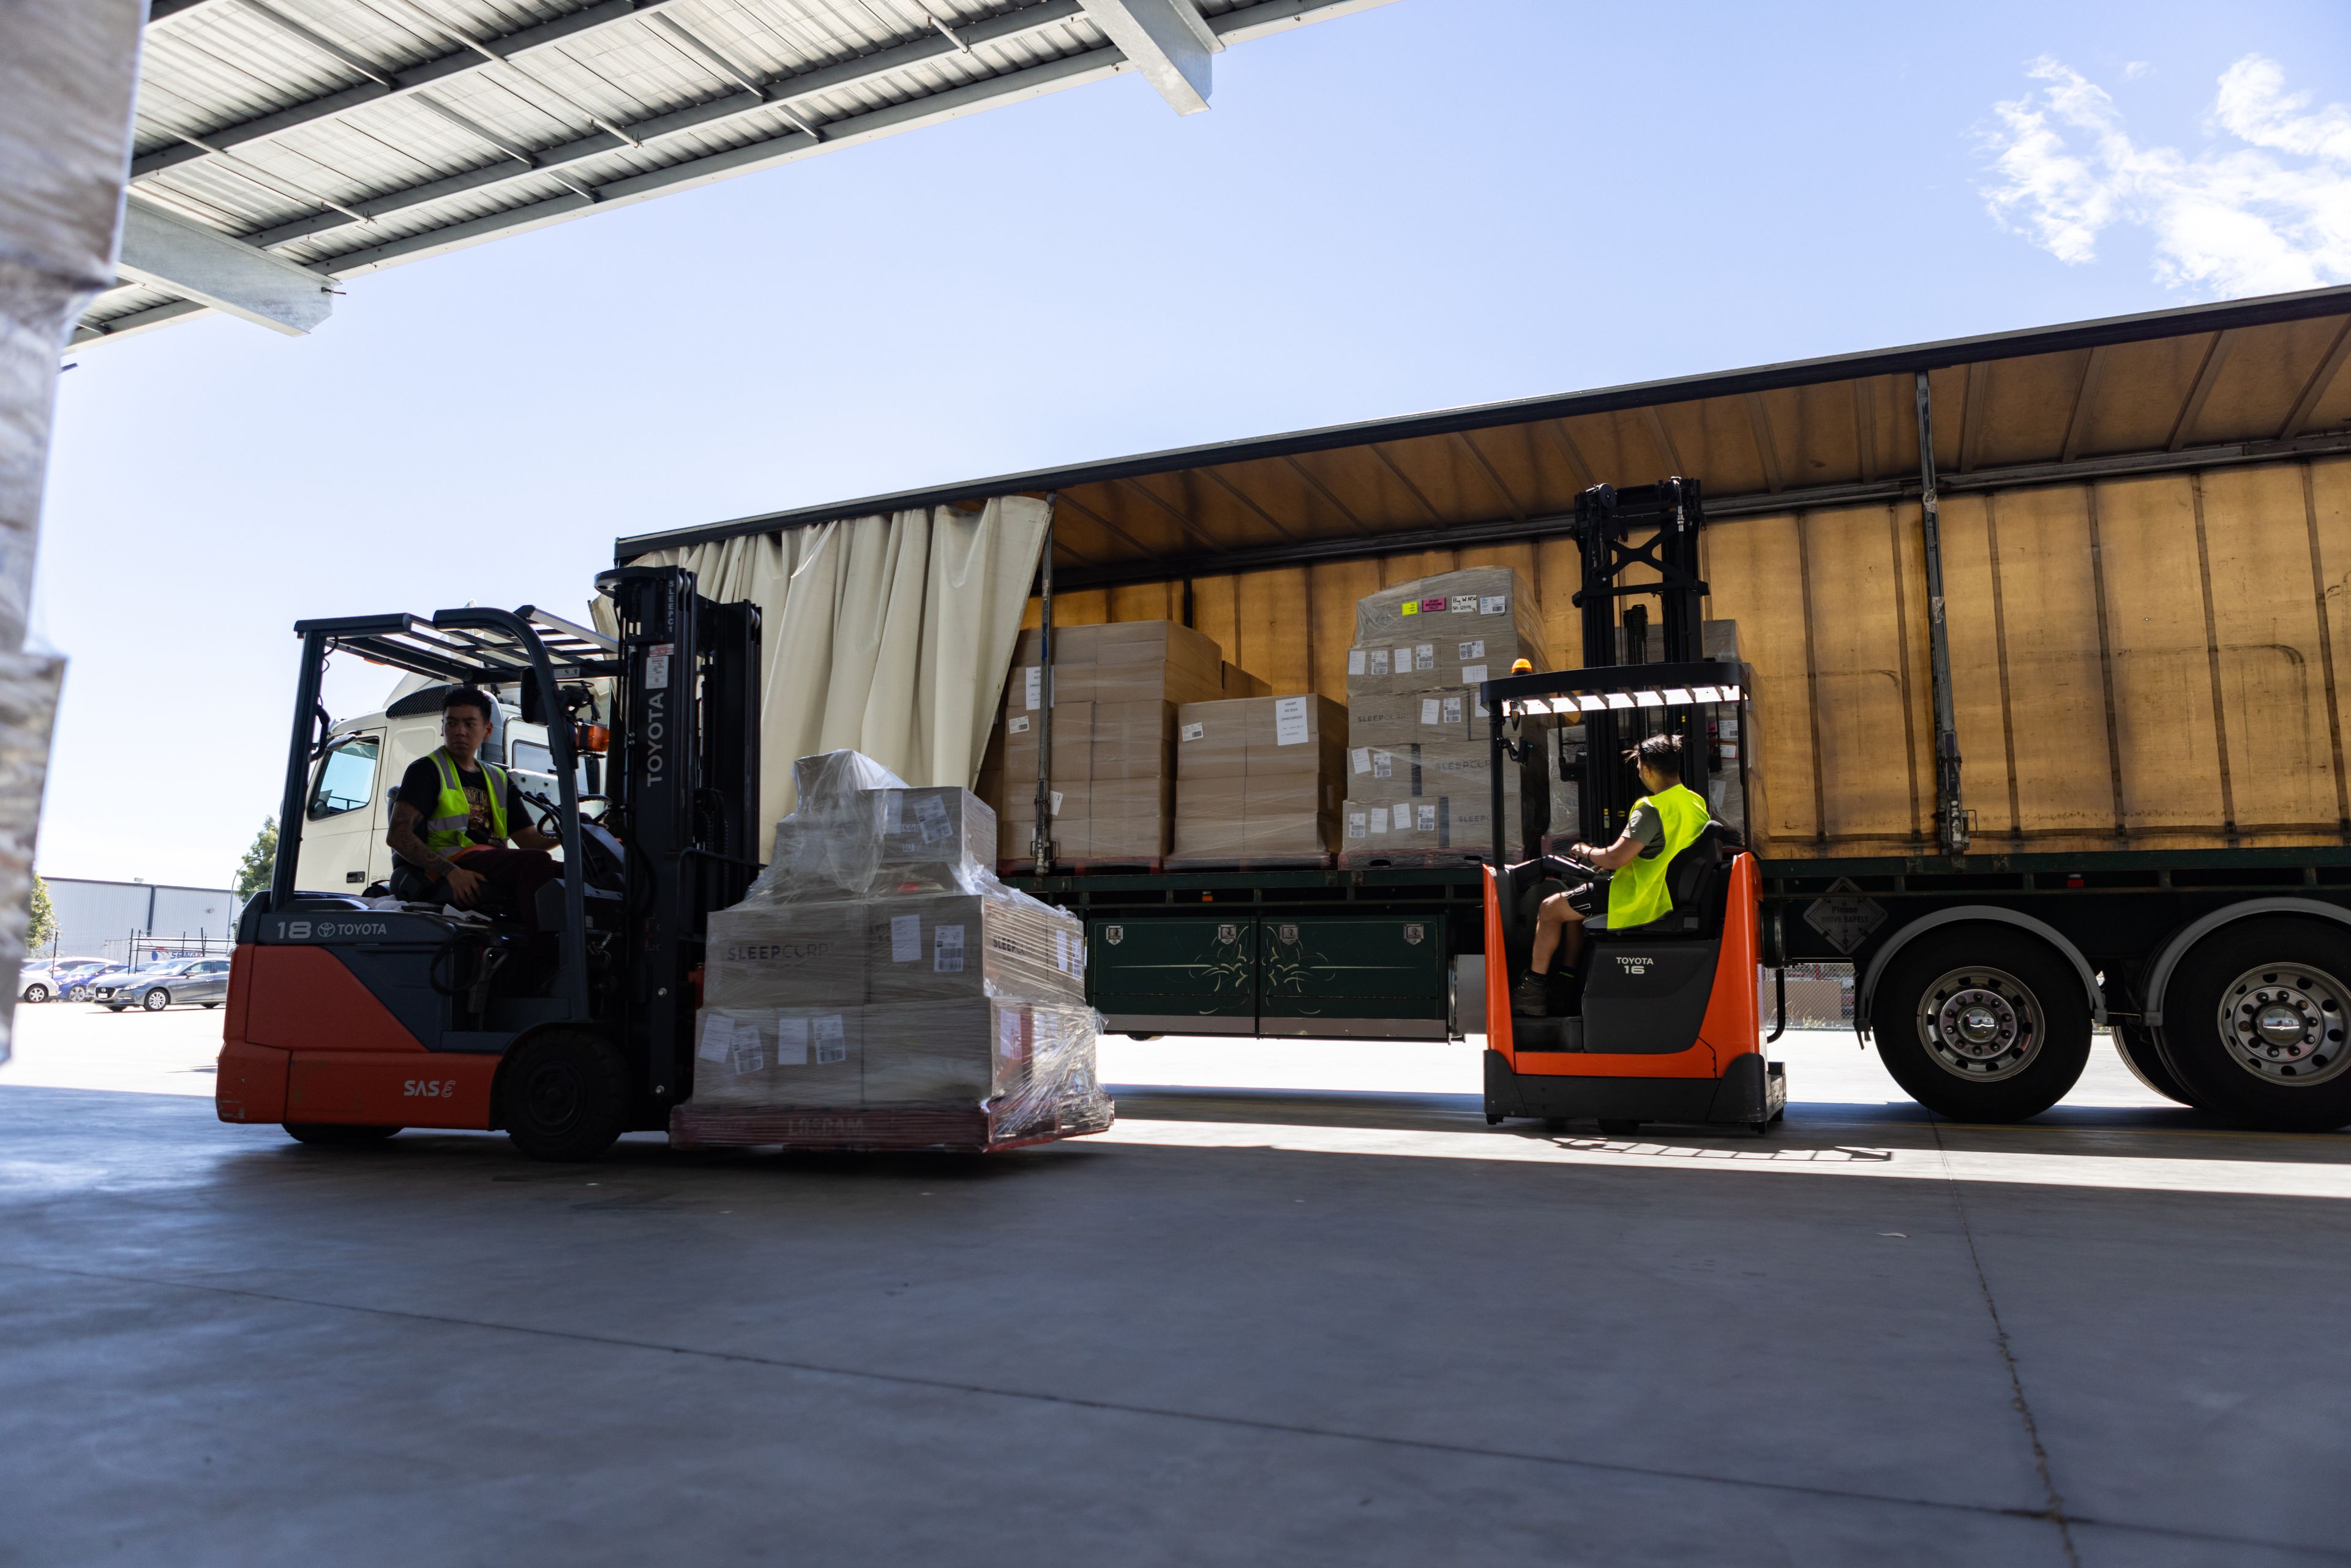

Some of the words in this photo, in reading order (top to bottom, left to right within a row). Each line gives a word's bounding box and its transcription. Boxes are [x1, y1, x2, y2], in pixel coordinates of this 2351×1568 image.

[647, 692, 664, 787] TOYOTA
[277, 921, 312, 939] 18
[338, 923, 387, 936] TOYOTA
[1624, 966, 1645, 975] 16
